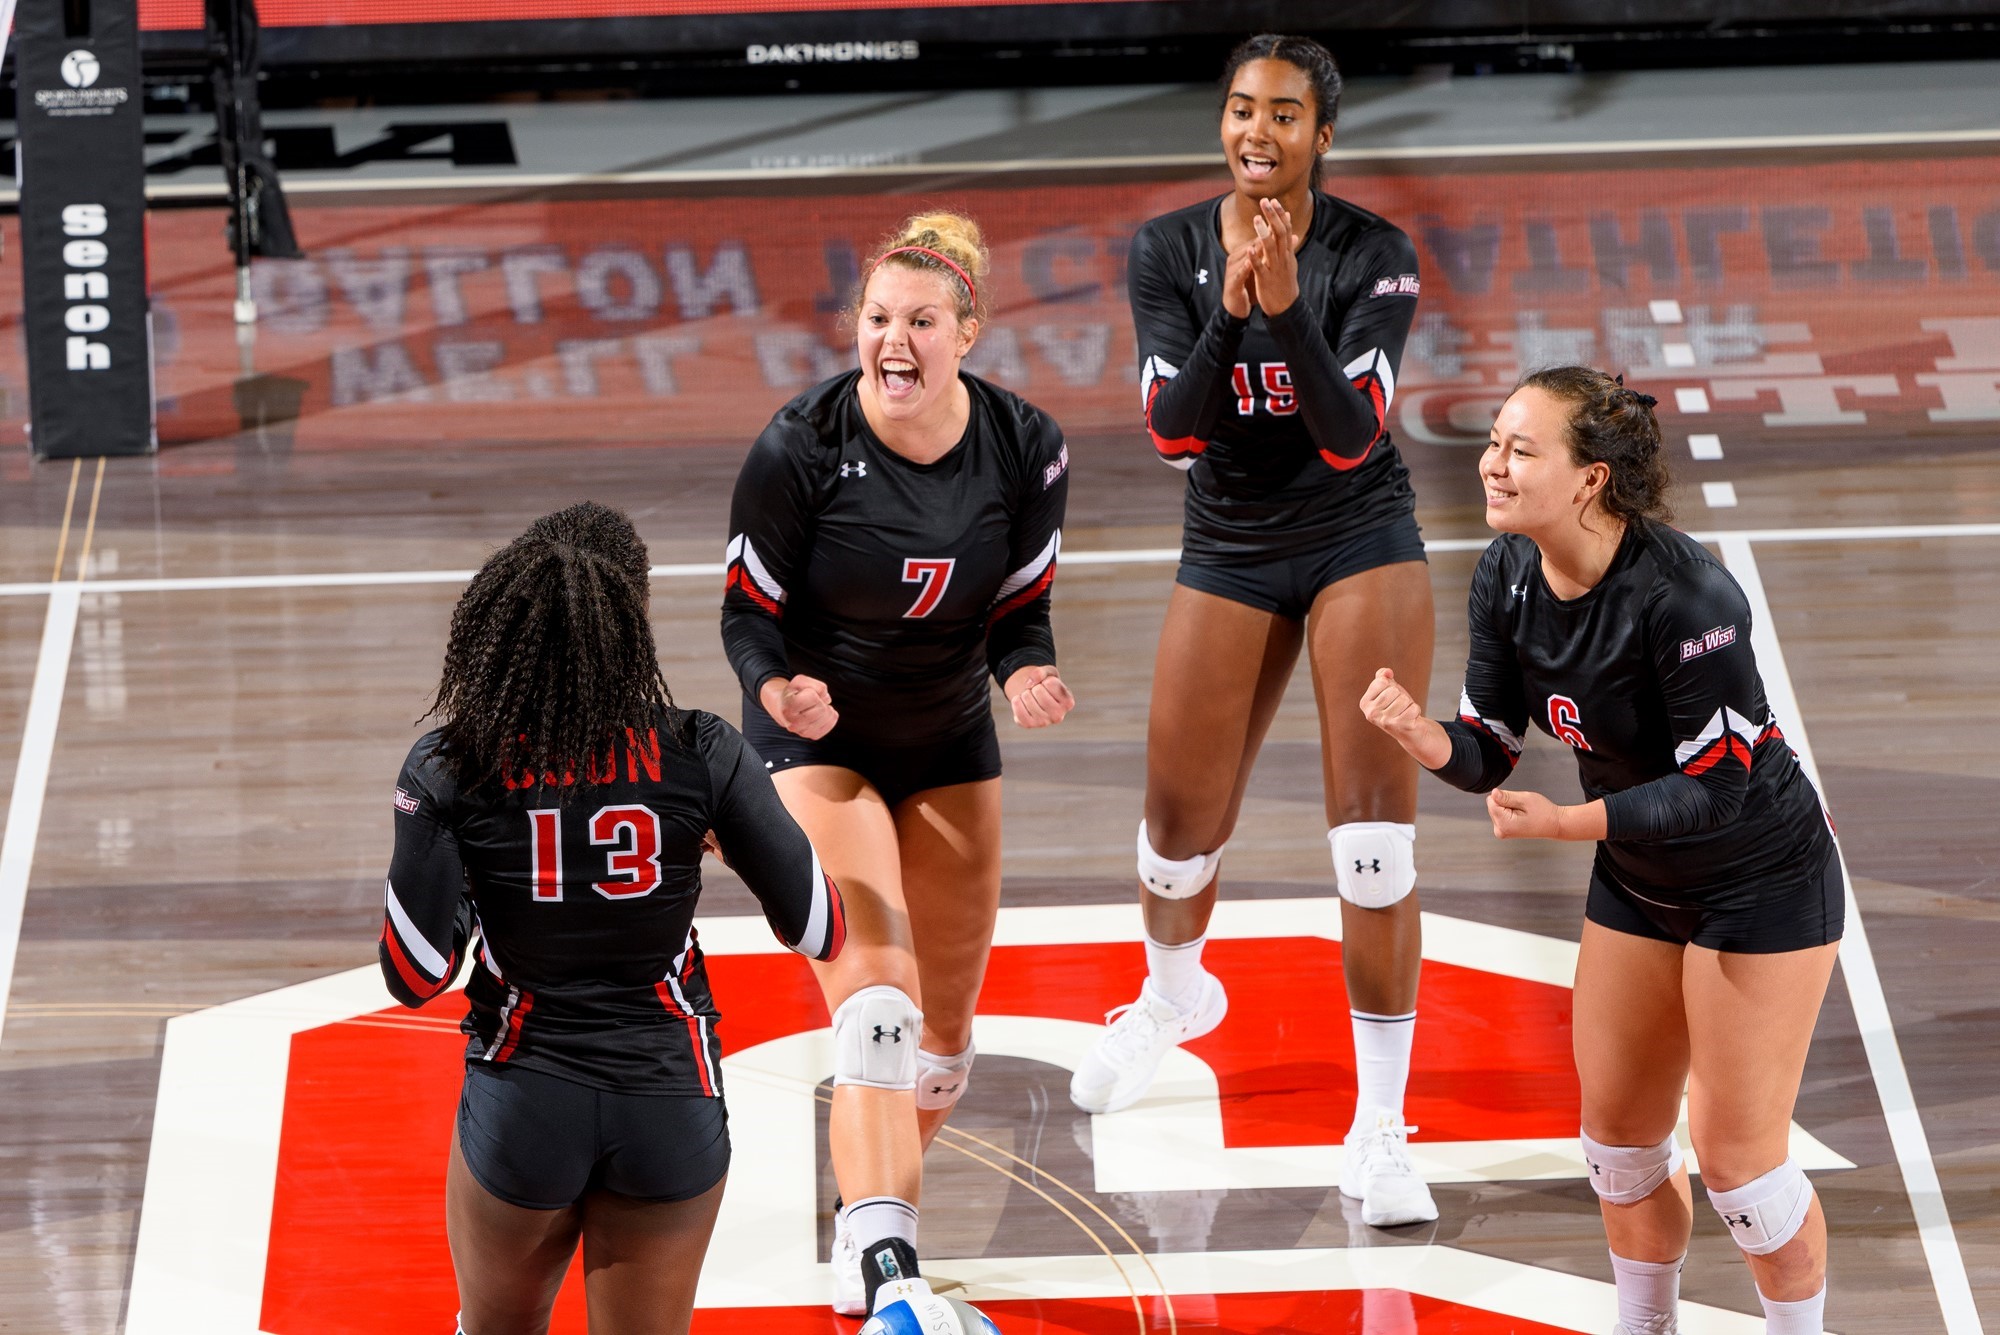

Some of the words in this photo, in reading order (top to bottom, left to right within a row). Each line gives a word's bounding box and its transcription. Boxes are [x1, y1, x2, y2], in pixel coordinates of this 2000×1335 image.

[61, 203, 112, 371] senoh
[1231, 362, 1299, 416] 15
[901, 557, 956, 619] 7
[1682, 640, 1704, 659] BIG
[1704, 628, 1735, 650] WEST
[1547, 693, 1592, 751] 6
[526, 803, 662, 902] 13
[924, 1303, 953, 1335] SUN
